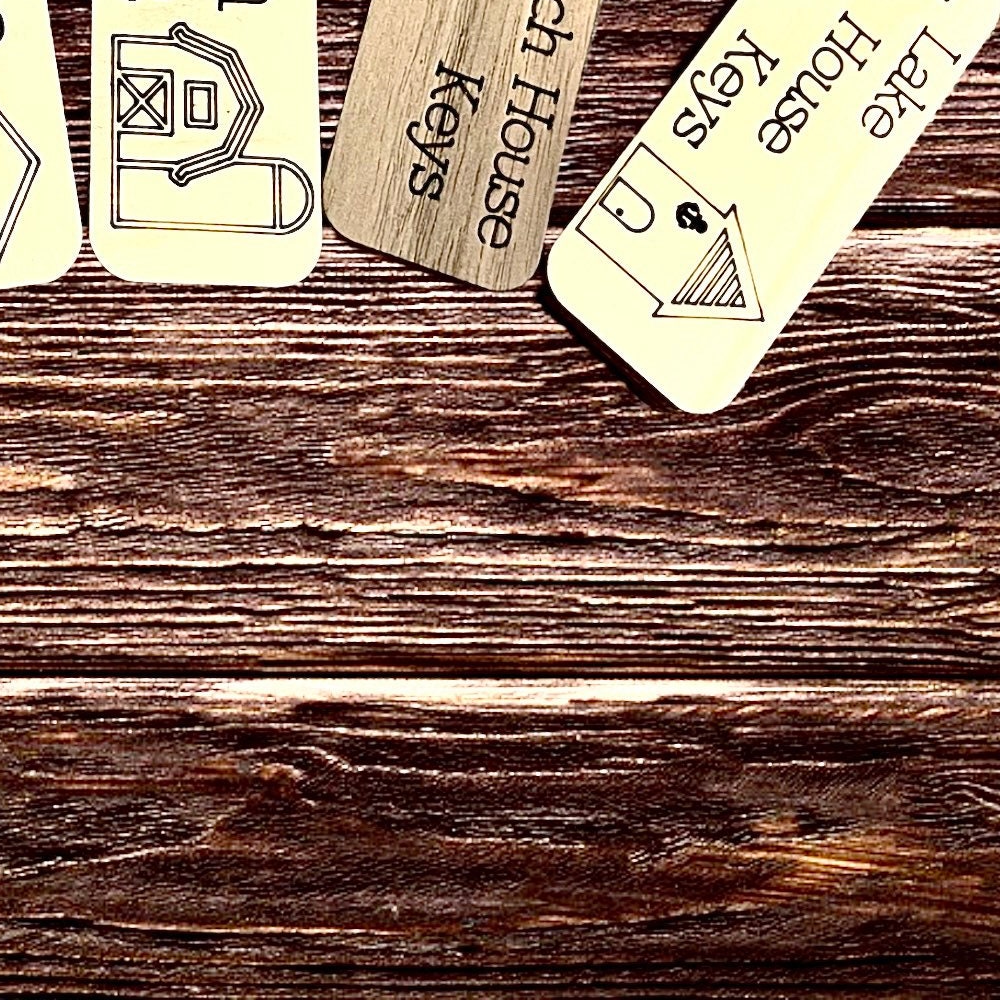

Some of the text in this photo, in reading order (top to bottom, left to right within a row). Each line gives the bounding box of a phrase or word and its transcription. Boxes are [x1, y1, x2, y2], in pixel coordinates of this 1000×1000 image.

[406, 59, 485, 202] Keys
[672, 29, 781, 149] Keys
[757, 10, 882, 155] House
[861, 25, 963, 140] Lake
[477, 72, 561, 251] House
